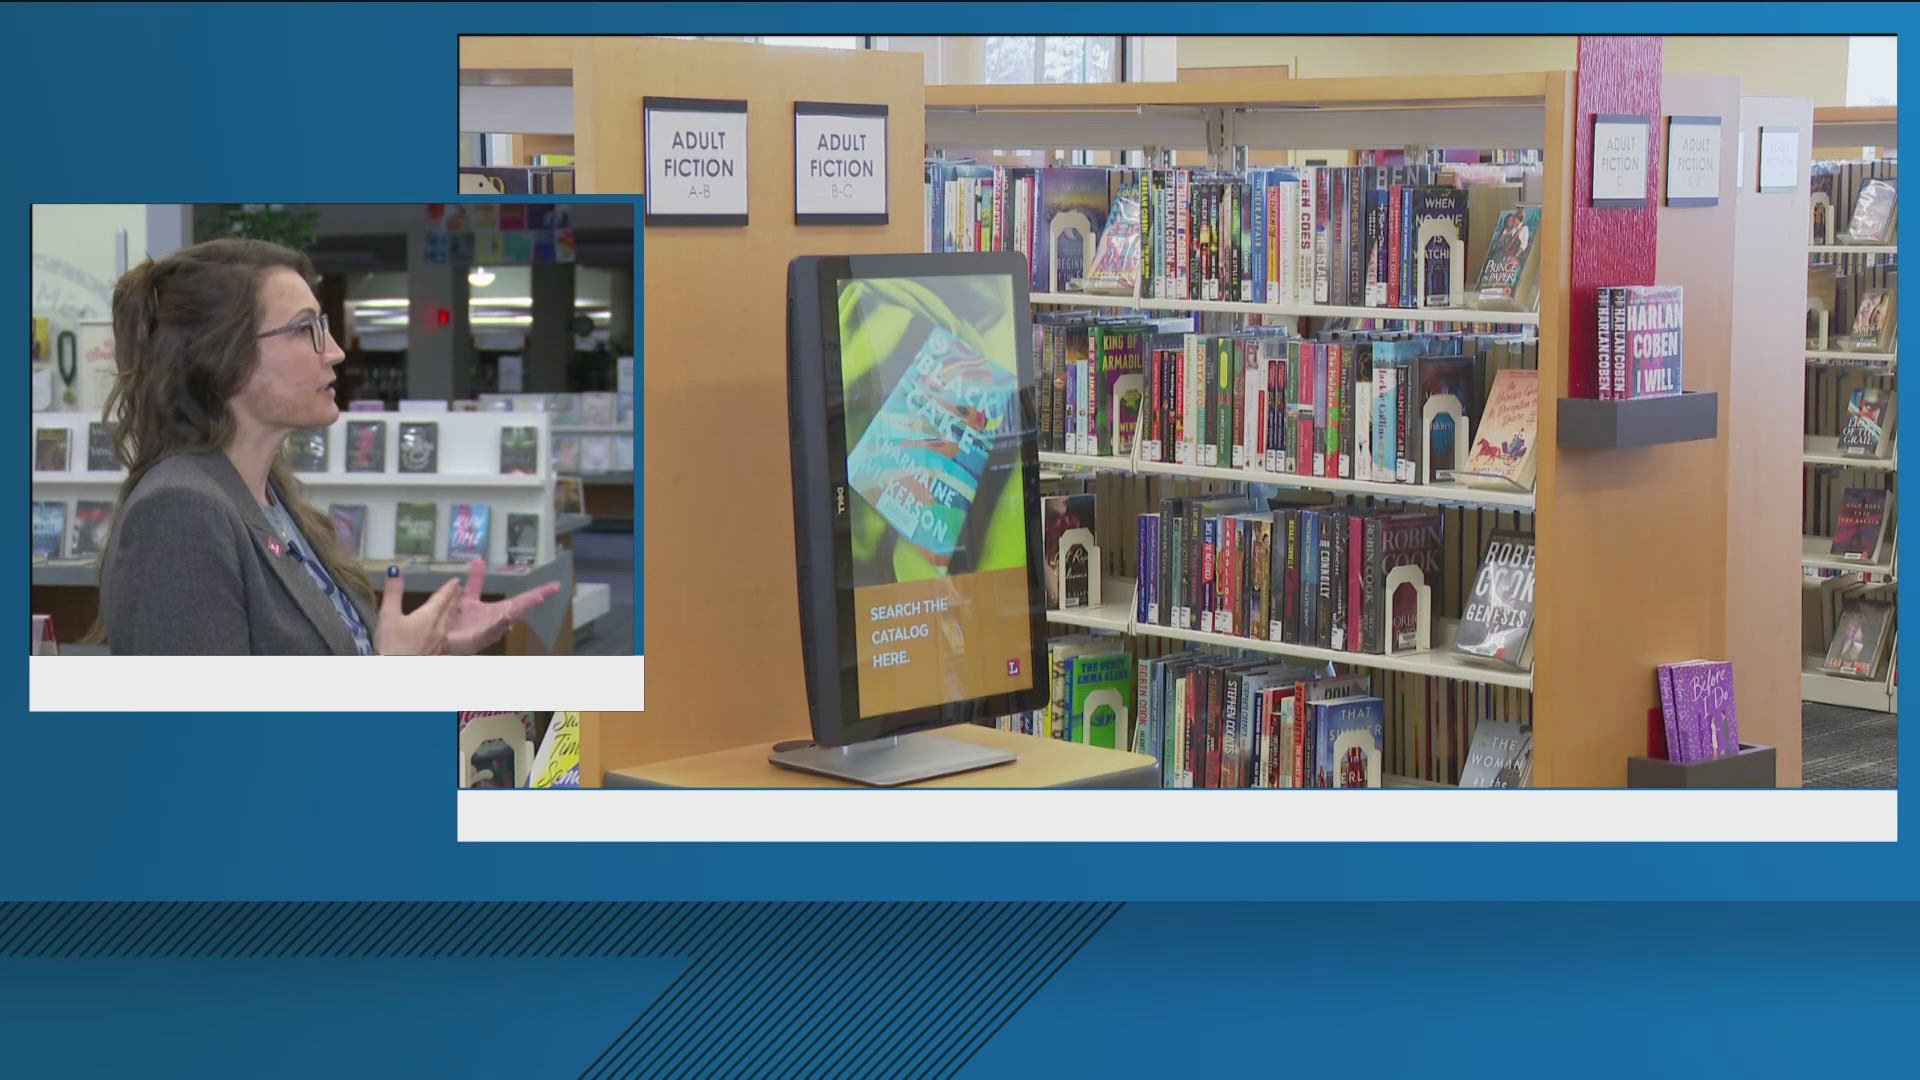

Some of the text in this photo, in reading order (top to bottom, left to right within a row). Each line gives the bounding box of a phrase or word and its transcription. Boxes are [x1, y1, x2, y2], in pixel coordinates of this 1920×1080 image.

[672, 131, 726, 150] ADULT
[817, 134, 866, 151] ADULT
[1606, 137, 1636, 151] ADULT
[1682, 138, 1711, 152] ADULT
[664, 159, 734, 177] FICTION
[810, 160, 873, 177] FICTION
[1602, 157, 1639, 171] FICTION
[1677, 157, 1713, 171] FICTION
[688, 185, 711, 199] A-B
[832, 184, 853, 198] B-C
[1424, 198, 1455, 209] WHEN
[1166, 188, 1175, 262] HARLAN COBEN
[1177, 188, 1187, 266] HARLAN COBEN
[1301, 180, 1310, 249] BEN COES
[1433, 235, 1443, 243] IS
[1317, 231, 1327, 282] THE ISLAN
[1485, 259, 1517, 273] PRINCE
[1627, 303, 1682, 332] HARLAN
[1103, 334, 1138, 350] KING OF
[1598, 307, 1610, 390] HARLAN COBEN
[1614, 308, 1625, 391] HARLAN COBEN
[1633, 331, 1678, 358] COBEN
[1102, 353, 1142, 371] ARMADIL
[916, 354, 1001, 419] BLACK
[1328, 351, 1337, 408] The Helpline
[1379, 370, 1388, 400] Jackie
[1636, 367, 1674, 393] I WILL
[906, 389, 979, 455] CAKE
[1379, 404, 1388, 439] Collins
[875, 434, 957, 508] CHARMAINE
[836, 486, 846, 516] DELL
[1382, 526, 1440, 553] ROBIN
[1320, 550, 1330, 598] CONNOLLY
[1365, 523, 1375, 604] ROBIN COOK
[1381, 549, 1440, 577] COOK
[870, 597, 948, 621] SEARCH THE
[1466, 603, 1527, 628] GENESIS
[871, 623, 929, 645] CATALOG
[872, 650, 911, 668] HERE.
[1008, 661, 1019, 675] L
[1077, 671, 1103, 684] EMMA
[1689, 668, 1726, 702] Before
[1139, 664, 1147, 725] ROBIN COOK
[1703, 686, 1729, 720] I Do
[1225, 680, 1237, 755] STEPHEN COONTS
[1341, 706, 1372, 720] THAT
[1492, 737, 1517, 751] THE
[1472, 753, 1523, 771] WOMAN
[1472, 777, 1508, 789] at the
